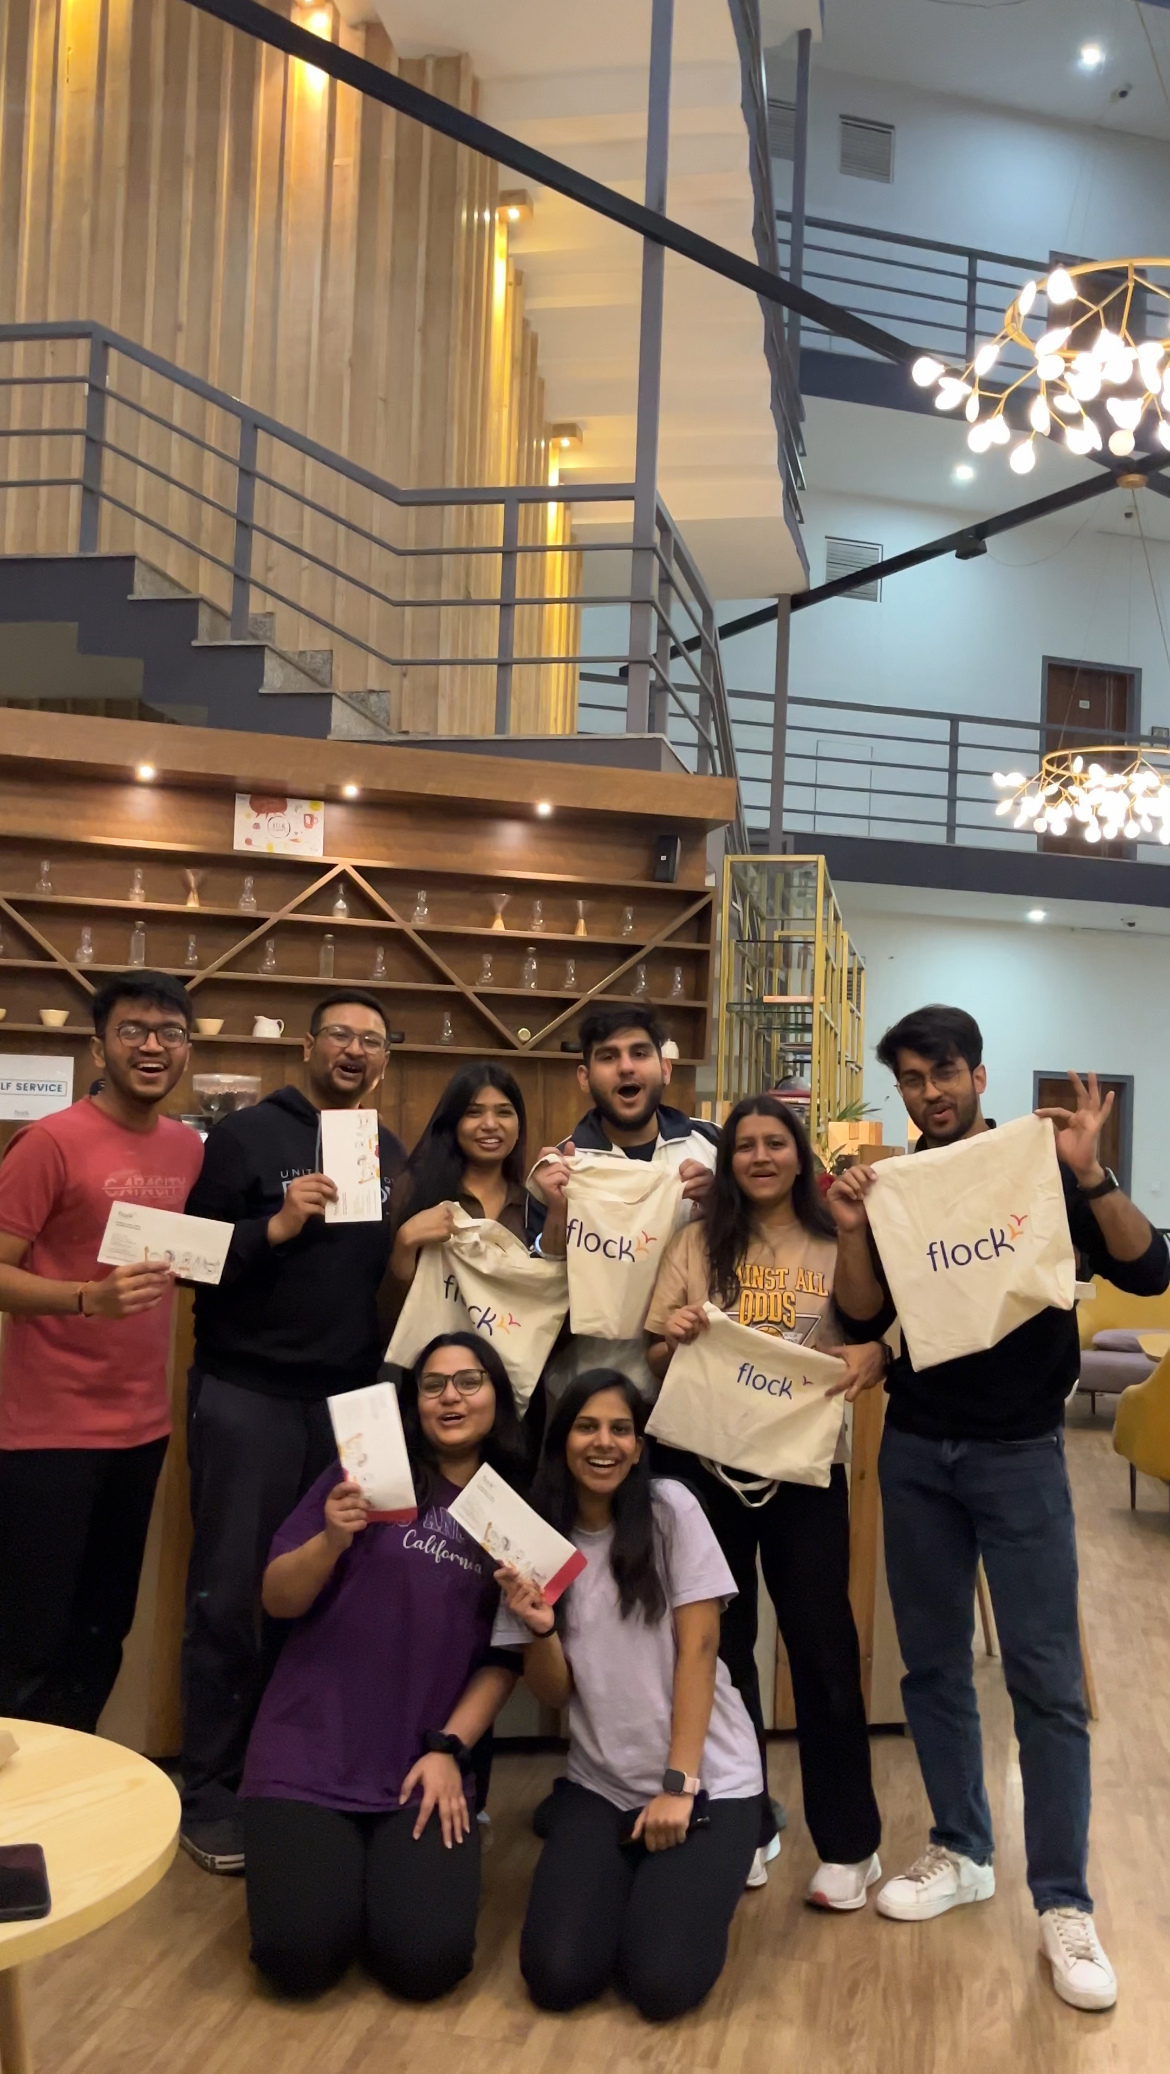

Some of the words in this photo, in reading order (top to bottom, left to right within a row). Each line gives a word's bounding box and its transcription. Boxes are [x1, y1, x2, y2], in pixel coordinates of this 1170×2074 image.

[16, 1082, 63, 1093] SERVICE
[566, 1218, 635, 1263] flock
[926, 1227, 1015, 1272] flock
[795, 1267, 829, 1297] ALL
[443, 1274, 496, 1336] flck
[739, 1289, 796, 1329] ODDS
[737, 1362, 792, 1400] flock
[402, 1529, 482, 1574] California
